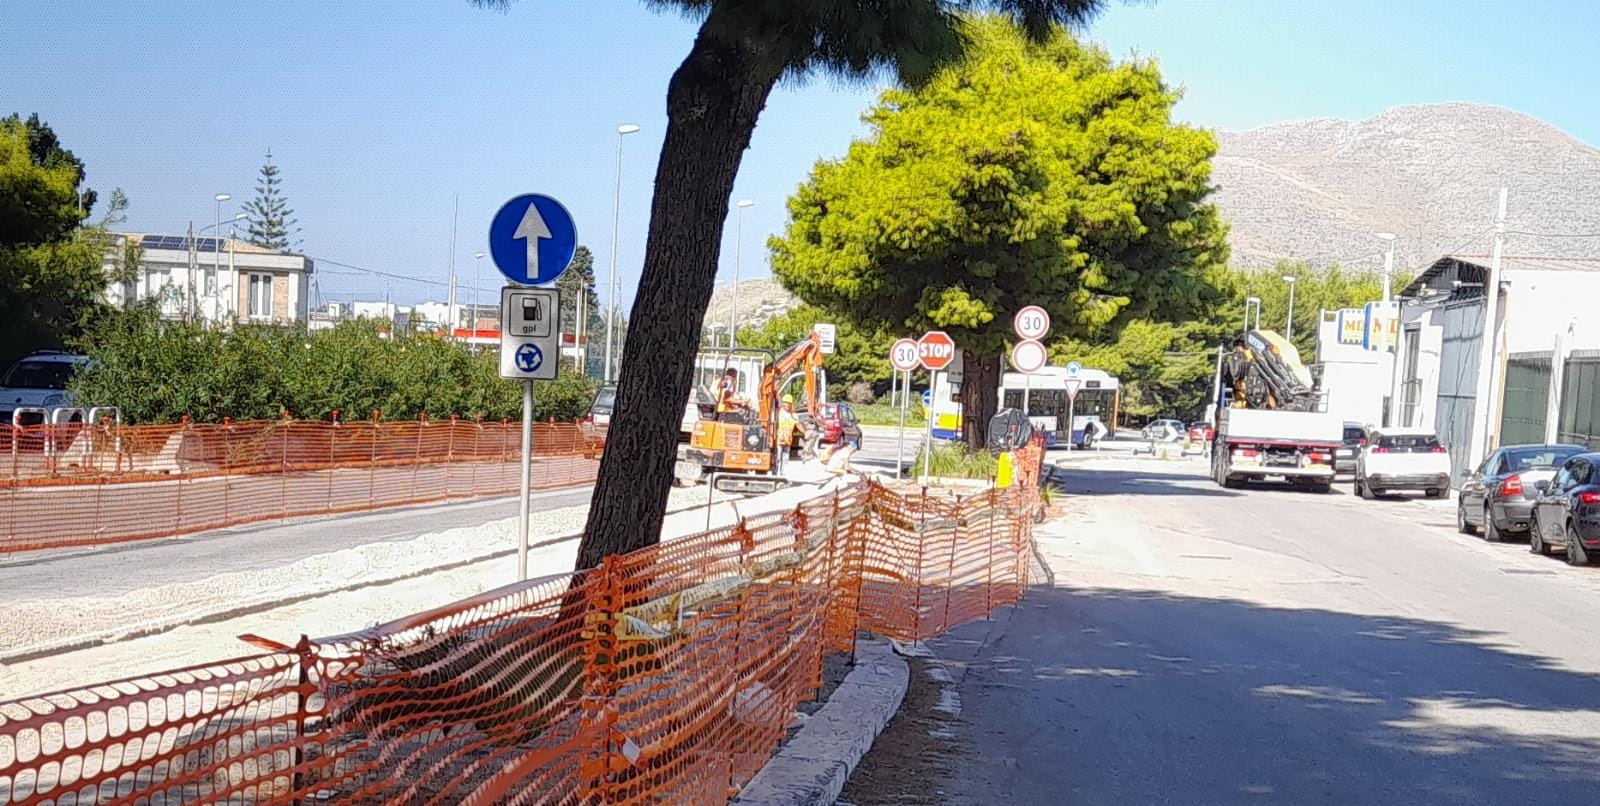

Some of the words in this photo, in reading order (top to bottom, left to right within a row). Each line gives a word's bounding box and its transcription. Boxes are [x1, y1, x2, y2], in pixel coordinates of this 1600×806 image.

[522, 324, 537, 334] gpl
[1023, 316, 1041, 330] 30
[898, 348, 914, 362] 30
[920, 343, 952, 358] STOP
